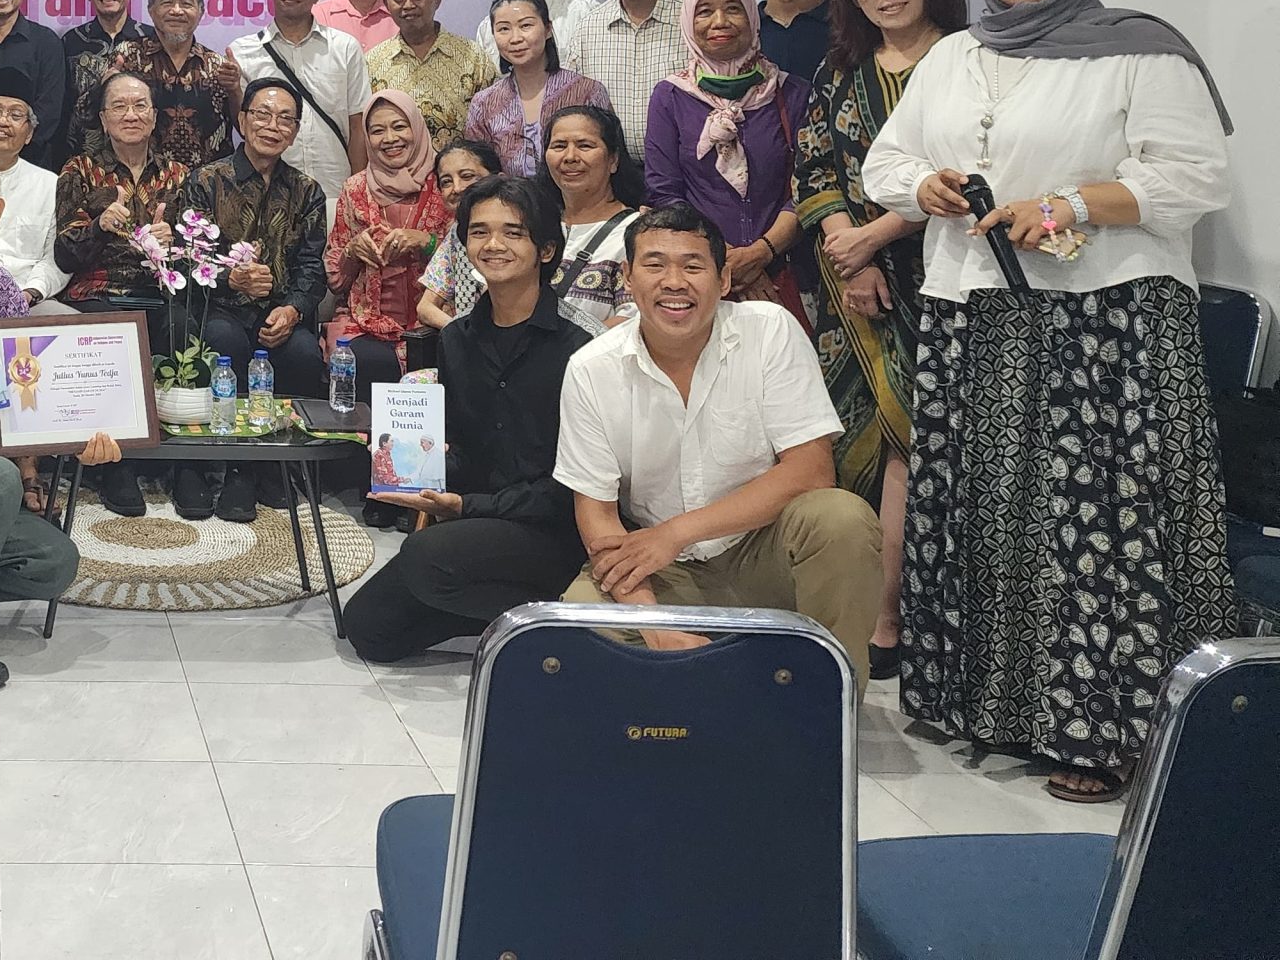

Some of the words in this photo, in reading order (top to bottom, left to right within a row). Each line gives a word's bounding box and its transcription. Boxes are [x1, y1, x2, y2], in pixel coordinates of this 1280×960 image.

[77, 336, 93, 346] ICRP
[64, 351, 103, 359] SERTIFIKAT
[52, 371, 74, 381] Julius
[75, 370, 98, 379] Yunus
[386, 397, 428, 407] Menjadi
[389, 408, 425, 419] Garam
[391, 420, 424, 430] Dunia
[643, 727, 688, 737] FUTURA
